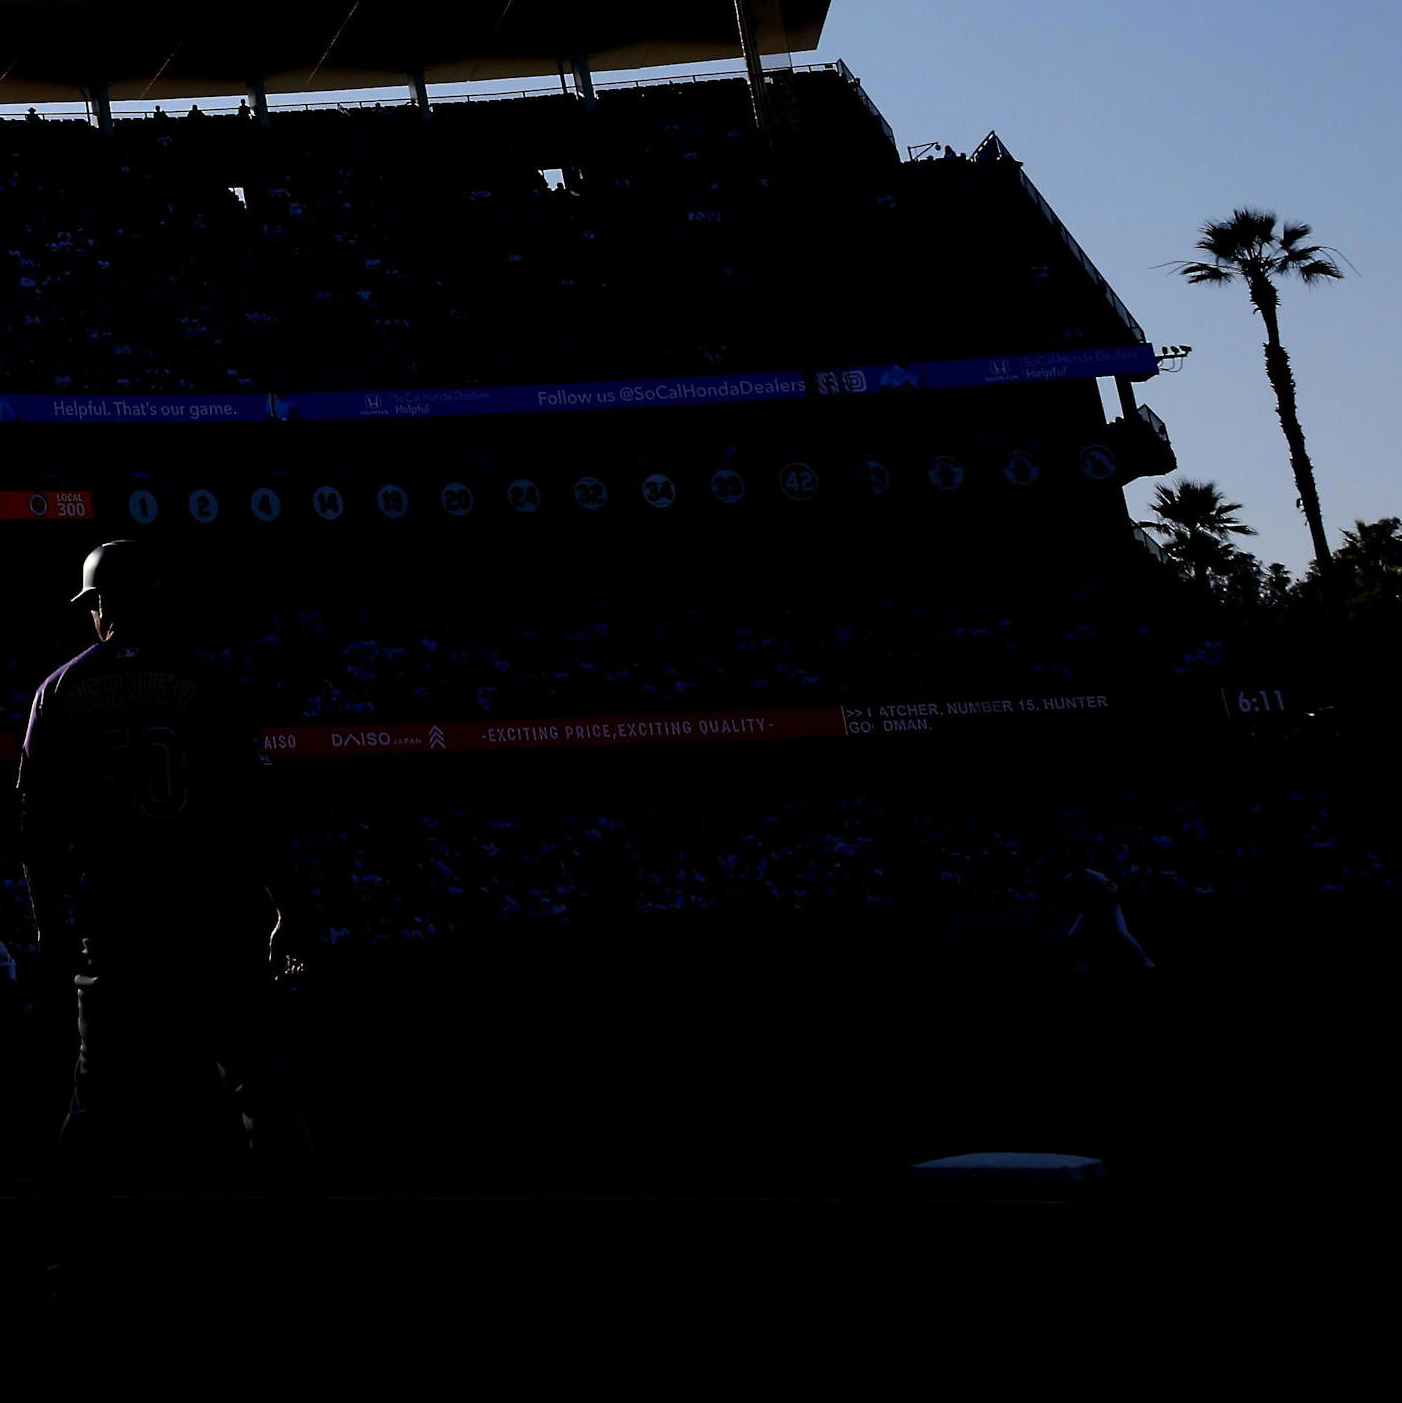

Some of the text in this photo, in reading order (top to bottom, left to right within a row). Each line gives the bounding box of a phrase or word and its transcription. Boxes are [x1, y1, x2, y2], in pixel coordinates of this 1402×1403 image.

[1025, 366, 1069, 380] Helpful
[537, 376, 807, 407] Follow us @SoCalHondaDealers
[52, 401, 238, 421] Helpful. That's our game.
[395, 404, 431, 416] Helpful
[785, 471, 815, 492] 42
[56, 494, 85, 503] LOCAL
[57, 502, 86, 518] 300
[947, 697, 1014, 717] NUMBER
[1043, 693, 1109, 711] HUNTER
[1236, 688, 1285, 714] 6:11
[331, 731, 391, 748] DAISO
